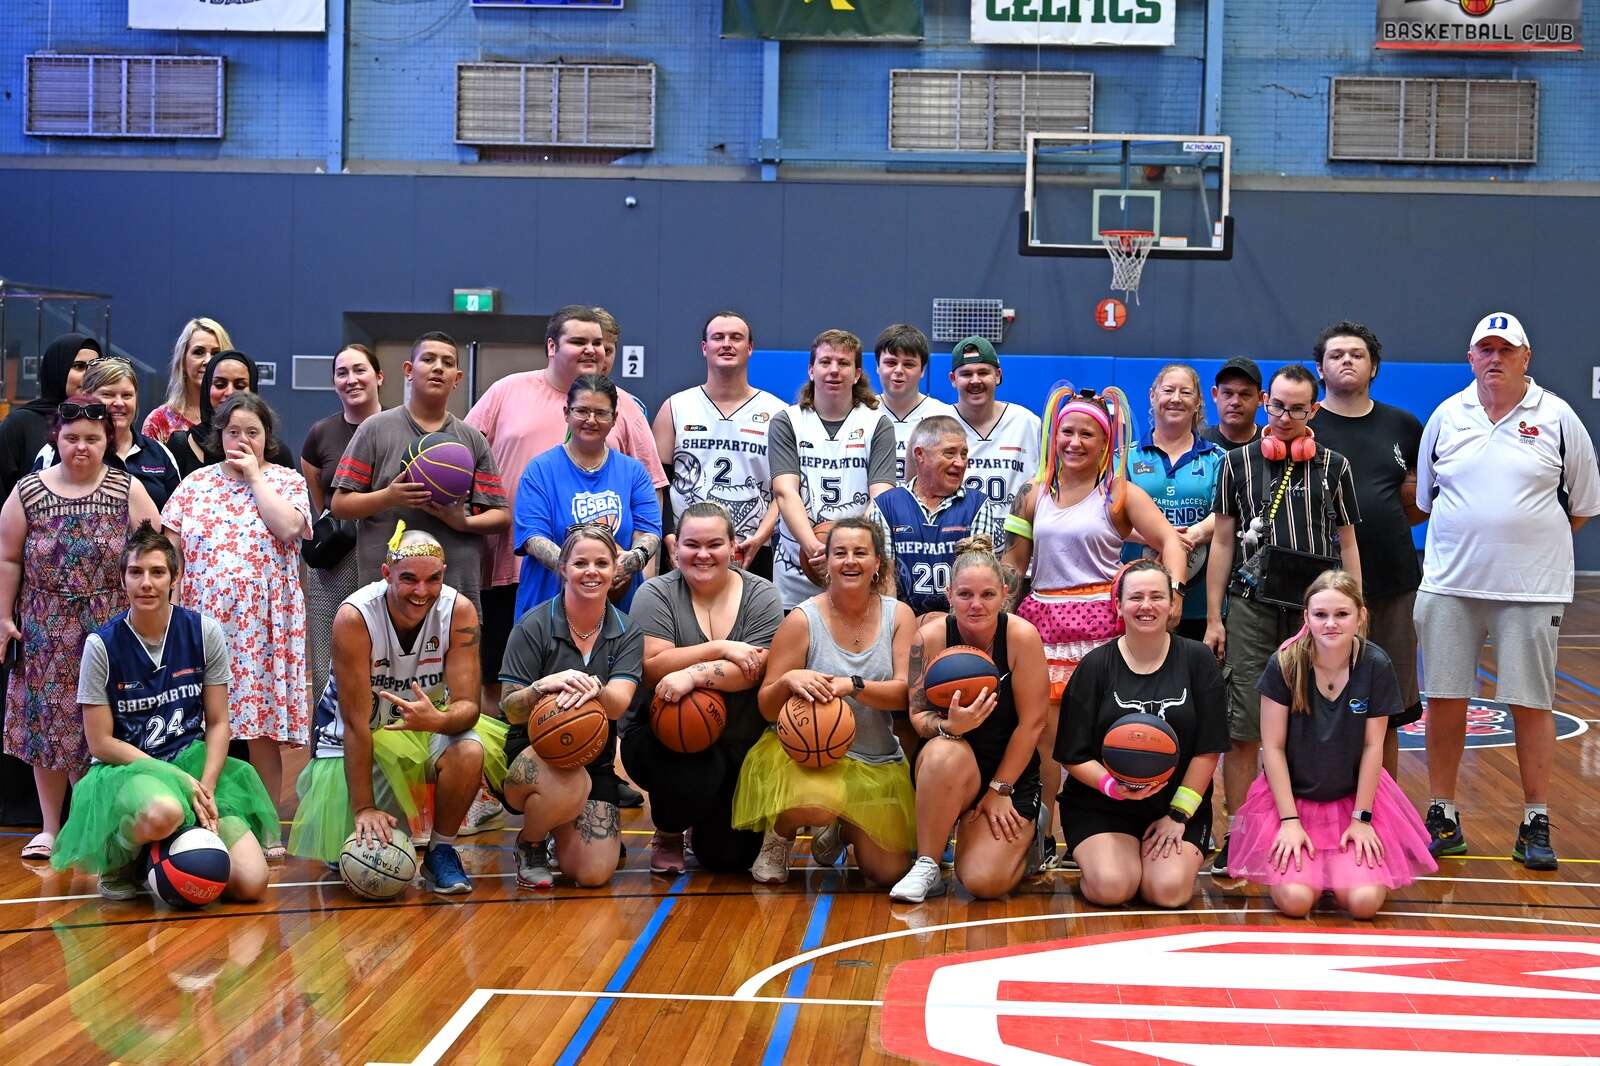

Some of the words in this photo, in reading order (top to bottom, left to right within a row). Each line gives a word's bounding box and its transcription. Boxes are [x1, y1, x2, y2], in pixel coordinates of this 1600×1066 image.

[1384, 22, 1515, 41] BASKETBALL
[1521, 24, 1574, 41] CLUB
[1185, 143, 1221, 151] ACROMAT
[1104, 302, 1117, 327] 1
[629, 362, 637, 375] 2
[682, 438, 768, 456] SHEPPARTON
[712, 457, 732, 485] 2
[967, 458, 1025, 473] PPARTON
[821, 476, 841, 505] 5
[576, 496, 618, 519] GSBA
[1153, 497, 1178, 506] PARTON
[1180, 497, 1208, 506] ACCESS
[1160, 506, 1205, 525] ENDS
[895, 541, 956, 555] HEPPART
[912, 562, 951, 594] 20
[117, 683, 203, 713] SHEPPARTON
[145, 707, 185, 749] 24
[361, 850, 401, 875] STADIUM
